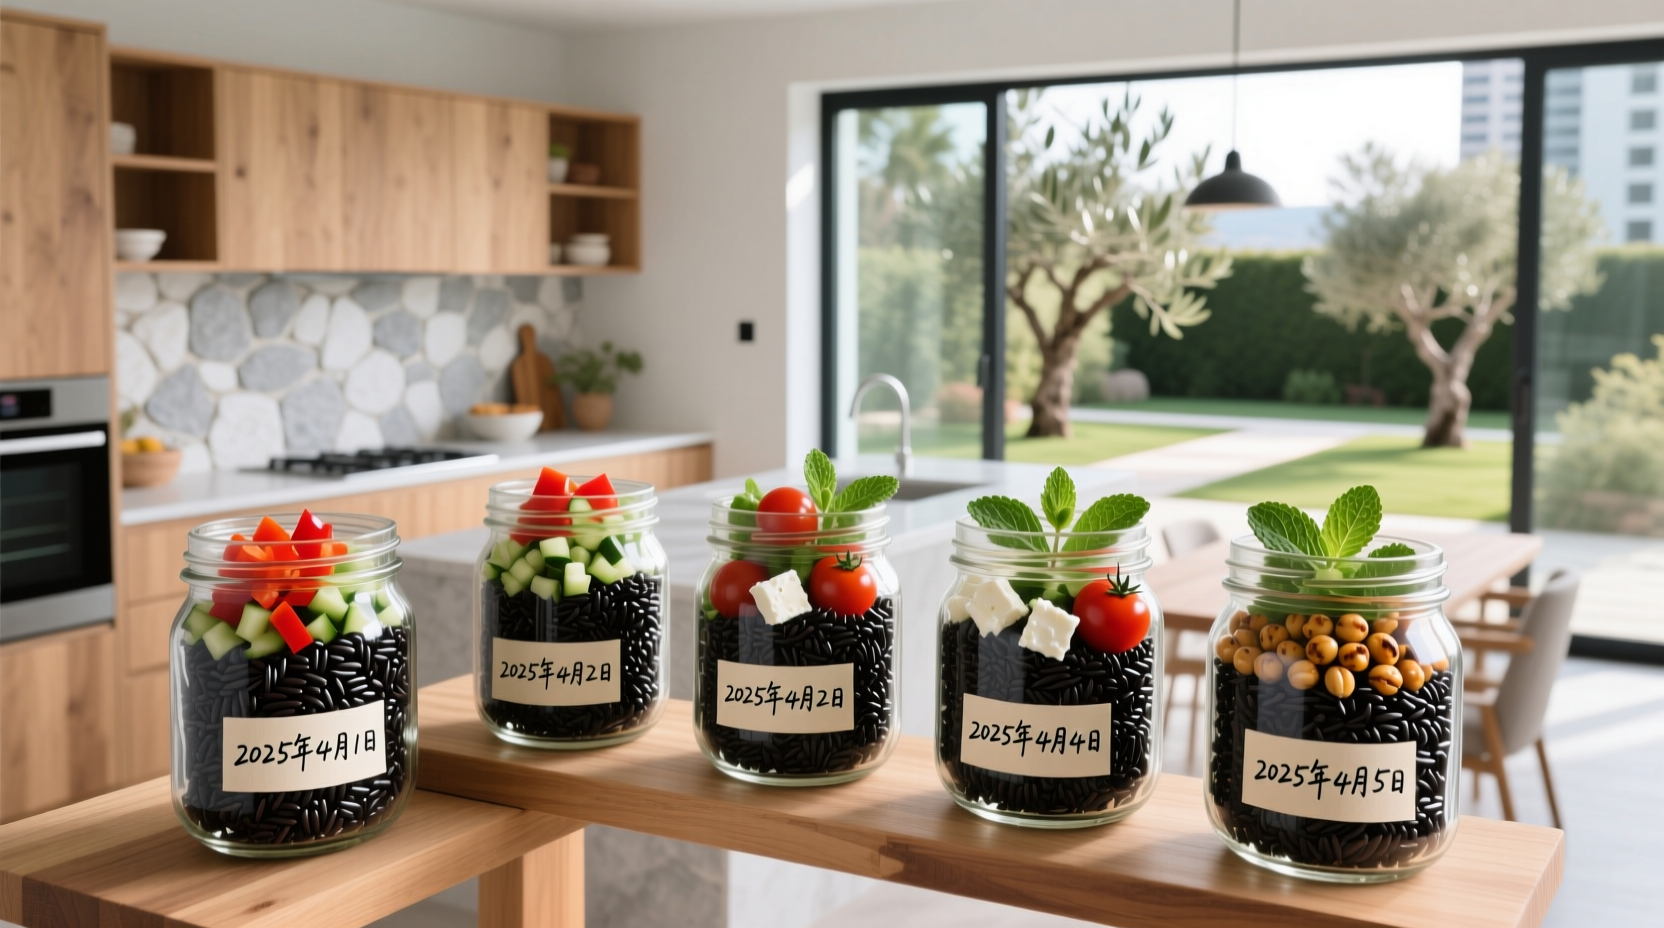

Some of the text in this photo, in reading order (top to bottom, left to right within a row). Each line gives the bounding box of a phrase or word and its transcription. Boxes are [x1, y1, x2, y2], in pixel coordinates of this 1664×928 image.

[499, 656, 612, 691] 2025年4月2日
[724, 680, 844, 717] 2025年4月2日
[233, 729, 376, 772] 2025年4月1日
[968, 719, 1101, 758] 2025年4月4日
[1253, 758, 1405, 801] 2025年4月5日
